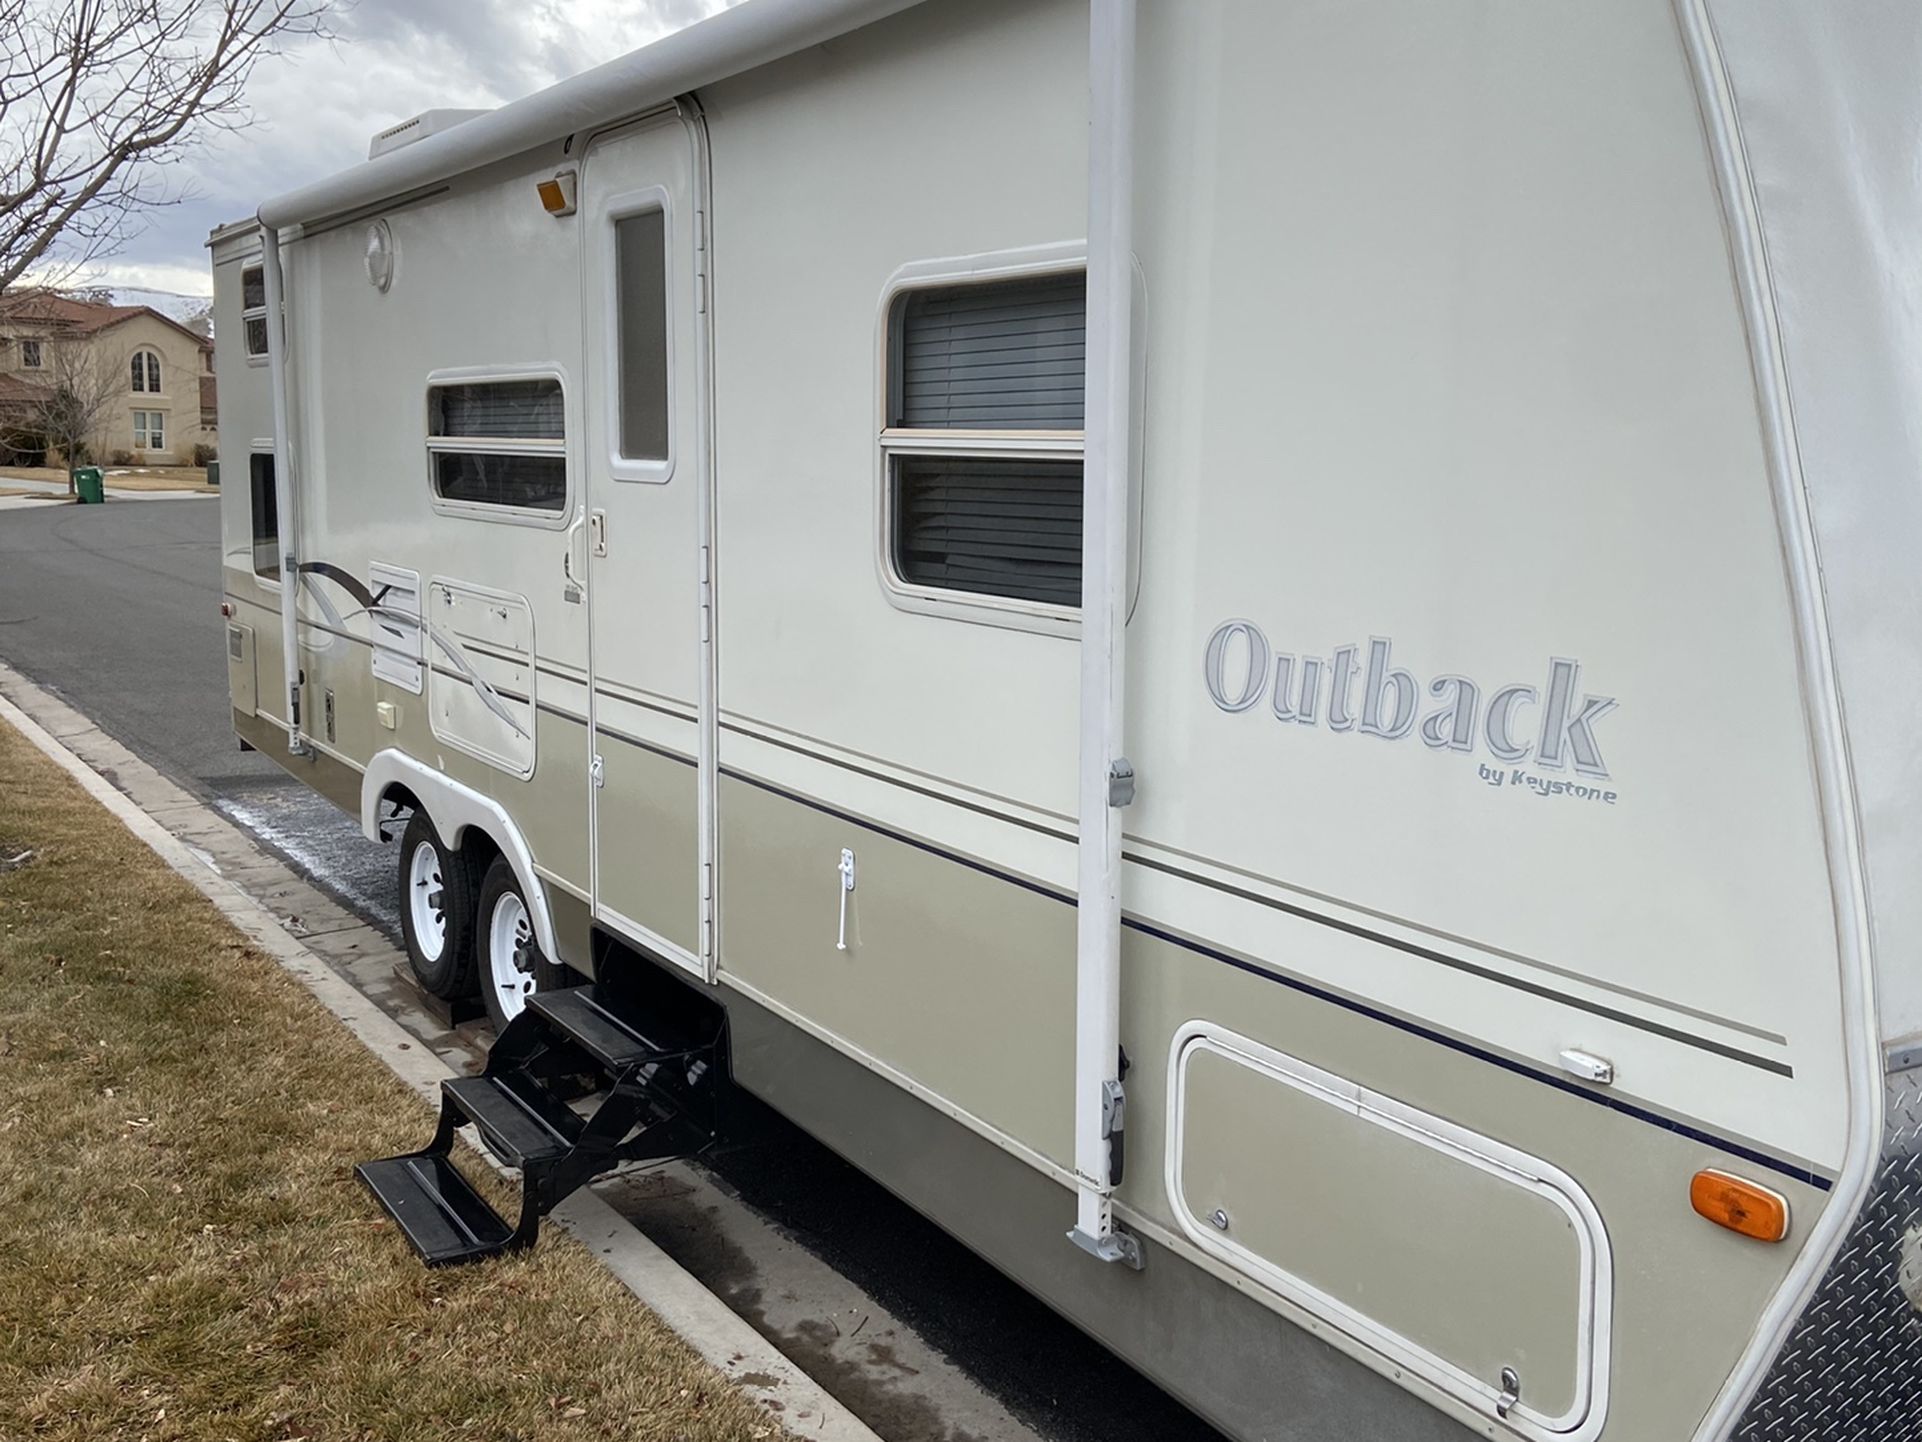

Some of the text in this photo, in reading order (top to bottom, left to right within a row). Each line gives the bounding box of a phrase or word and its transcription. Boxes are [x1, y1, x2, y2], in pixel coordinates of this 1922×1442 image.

[1204, 618, 1618, 779] Outback
[1478, 763, 1617, 804] by Keystone
